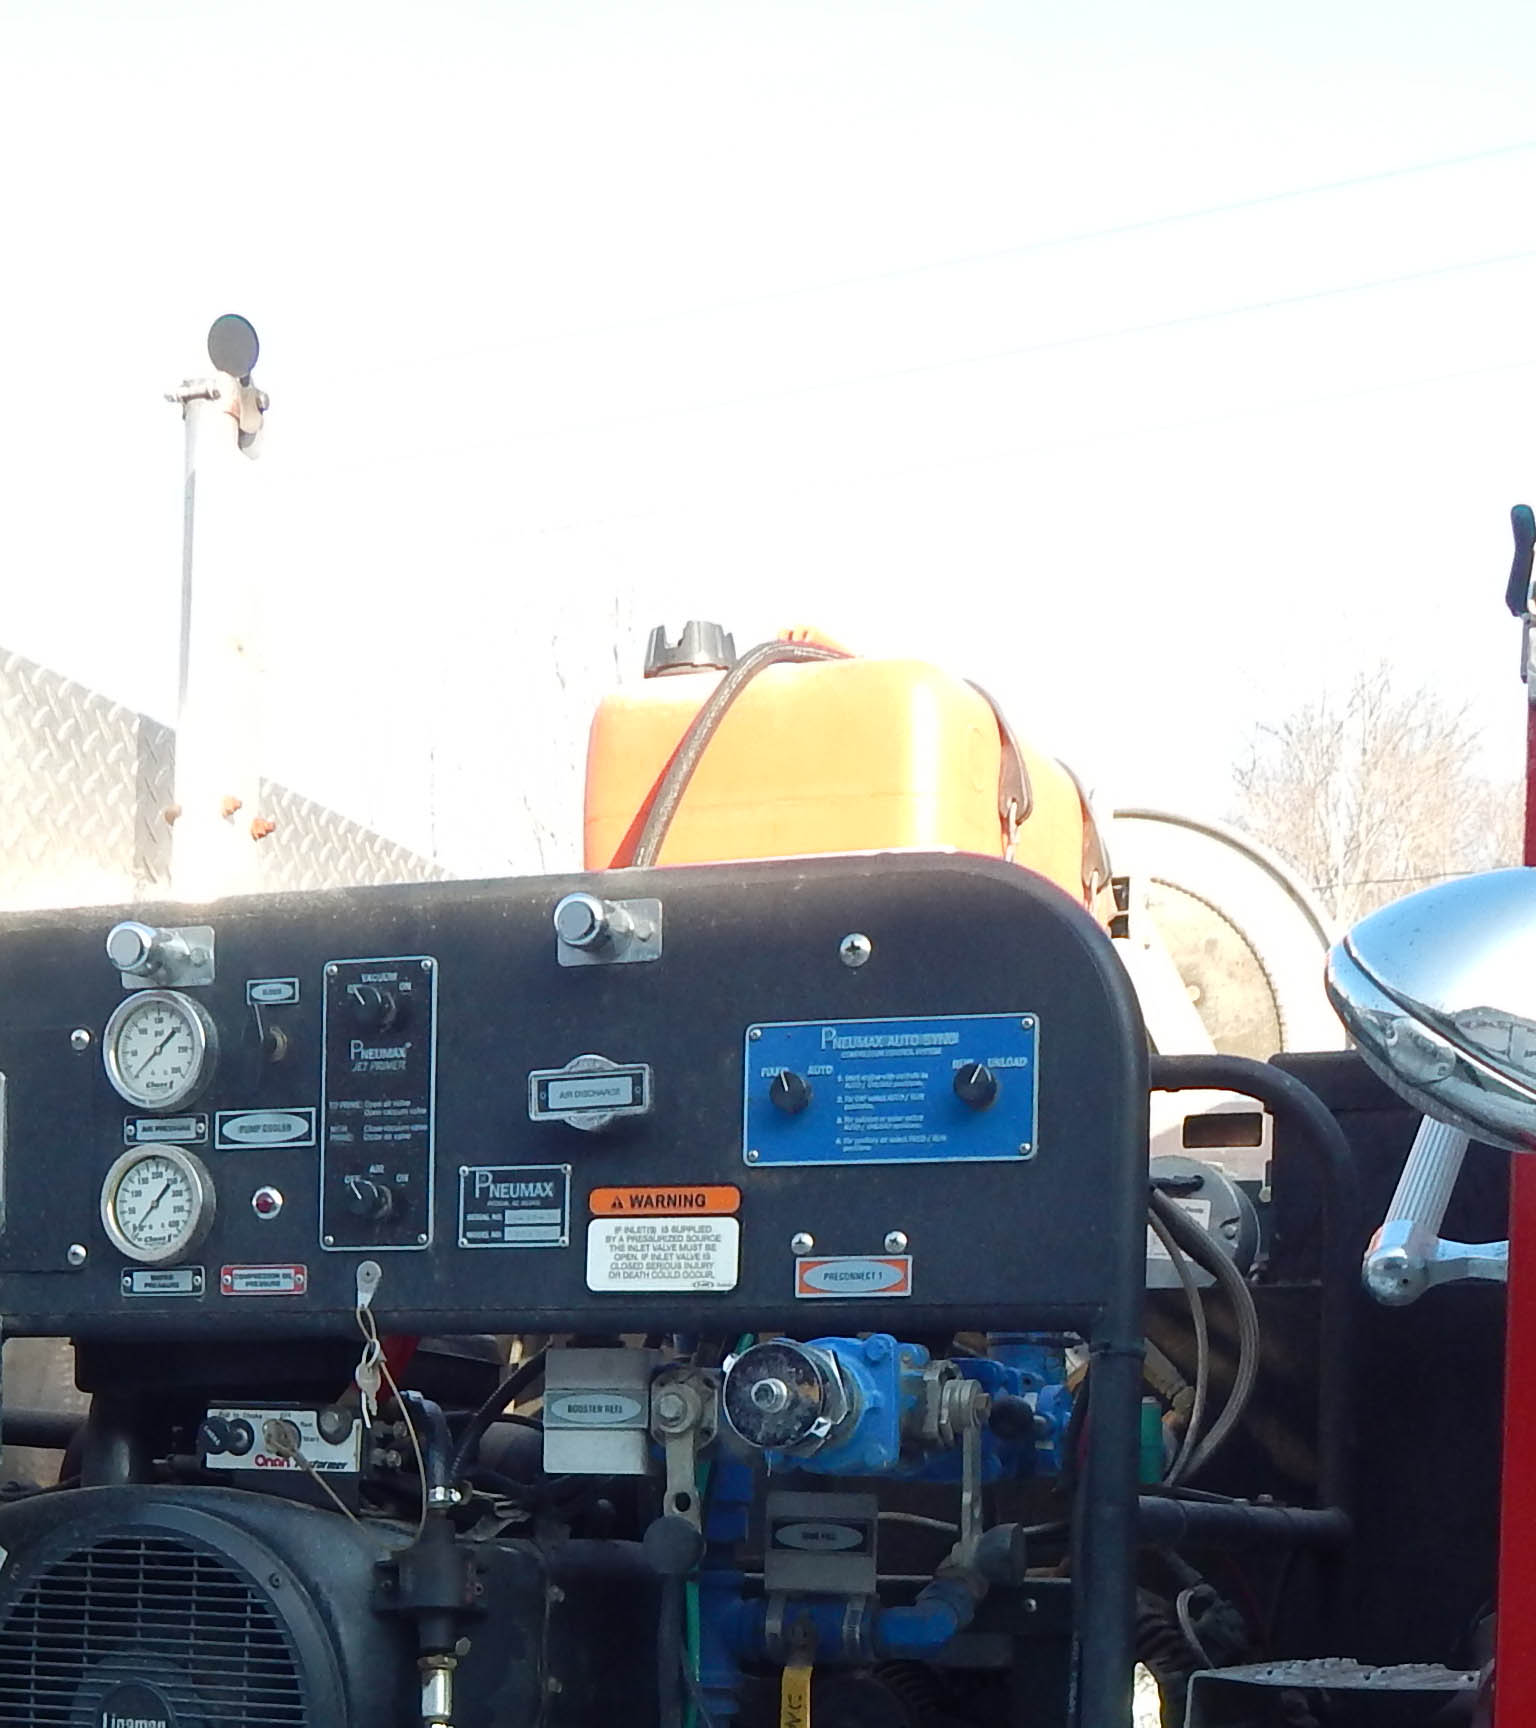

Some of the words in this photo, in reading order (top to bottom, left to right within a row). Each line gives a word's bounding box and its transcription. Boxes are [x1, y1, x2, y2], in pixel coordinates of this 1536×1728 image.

[887, 1034, 919, 1047] AUTO
[807, 1065, 834, 1076] AUTO
[475, 1170, 554, 1198] PNEUMAX
[629, 1193, 706, 1209] WARNING
[671, 1224, 712, 1234] SUPPLIED
[686, 1234, 721, 1243] SOURCE
[610, 1244, 625, 1252] THE
[627, 1244, 650, 1252] INLET
[652, 1243, 677, 1252] VALVE
[679, 1243, 703, 1252] MUST
[650, 1253, 674, 1261] INLET
[676, 1253, 700, 1261] VALVE
[610, 1262, 644, 1271] CLOSED
[645, 1262, 682, 1270] SERIOUS
[683, 1262, 715, 1270] INJURY
[622, 1271, 650, 1279] DEATH
[651, 1271, 681, 1279] COULD
[255, 1454, 290, 1468] Onan
